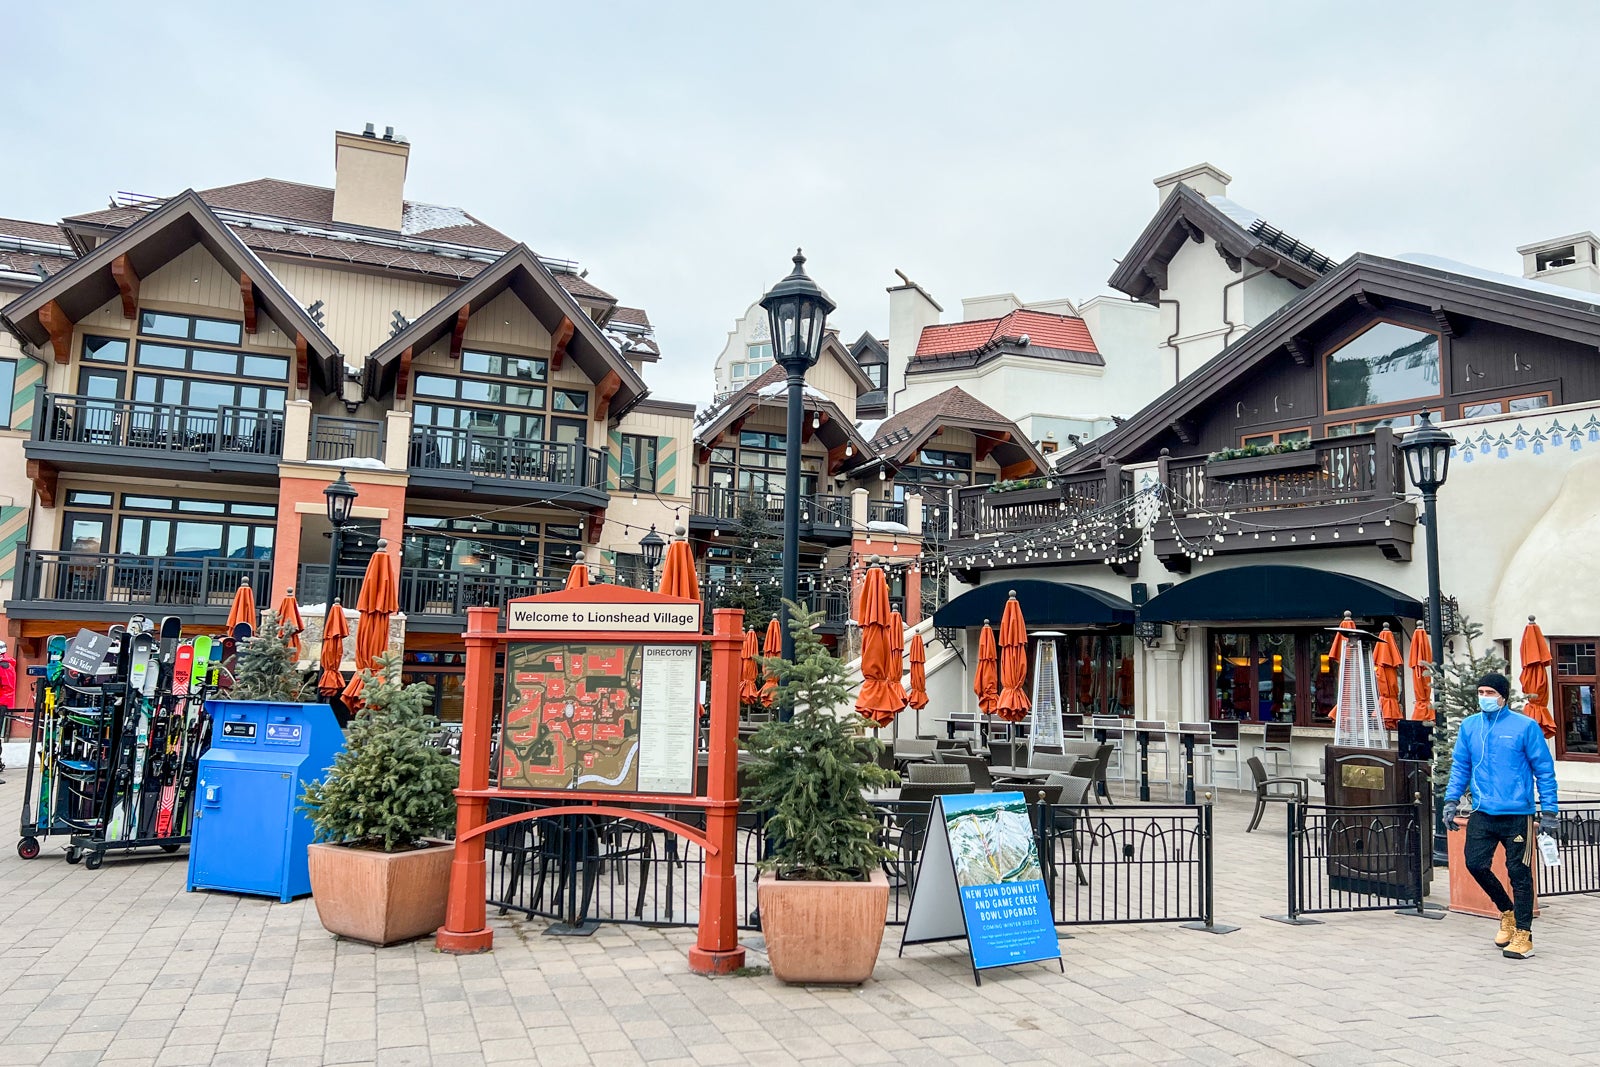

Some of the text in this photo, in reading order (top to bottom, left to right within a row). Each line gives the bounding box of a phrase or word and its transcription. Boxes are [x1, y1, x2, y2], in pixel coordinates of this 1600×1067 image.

[515, 612, 693, 625] Welcome to Lionshead Village
[69, 657, 92, 671] Ski Valet
[966, 884, 1040, 899] NEW SUN DOWN LIFT
[976, 895, 1038, 909] AND GAME CREEK
[981, 907, 1037, 921] BOWL UPGRADE
